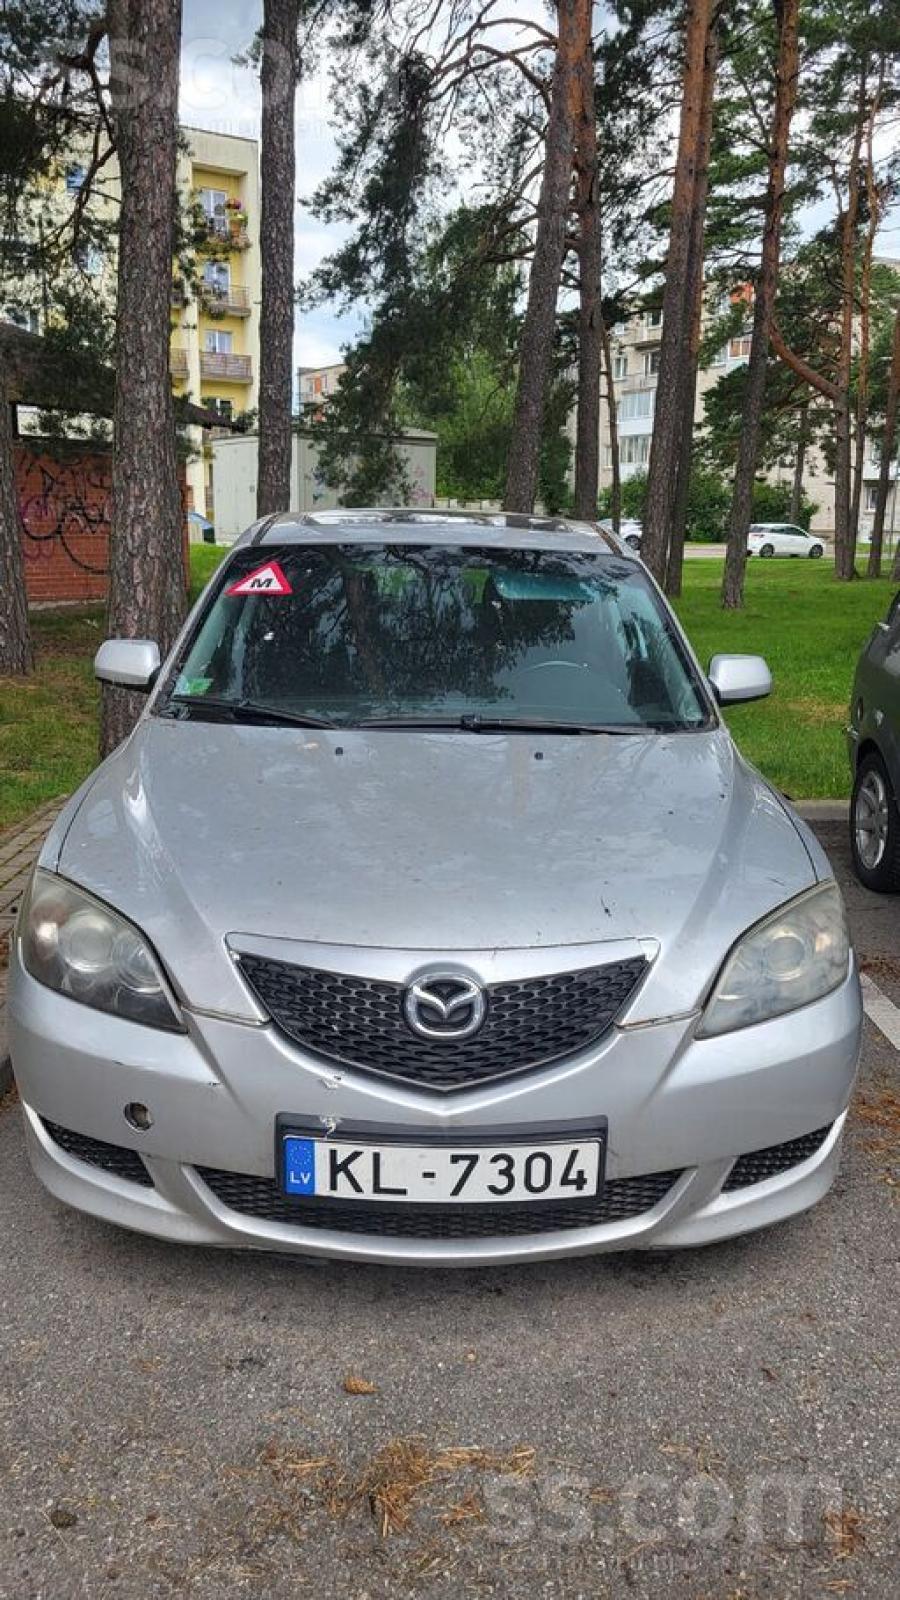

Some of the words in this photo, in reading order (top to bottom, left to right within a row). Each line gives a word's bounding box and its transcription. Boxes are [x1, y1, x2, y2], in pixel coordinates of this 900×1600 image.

[250, 578, 273, 588] M
[290, 1170, 311, 1184] LV
[329, 1149, 588, 1196] KL-7304
